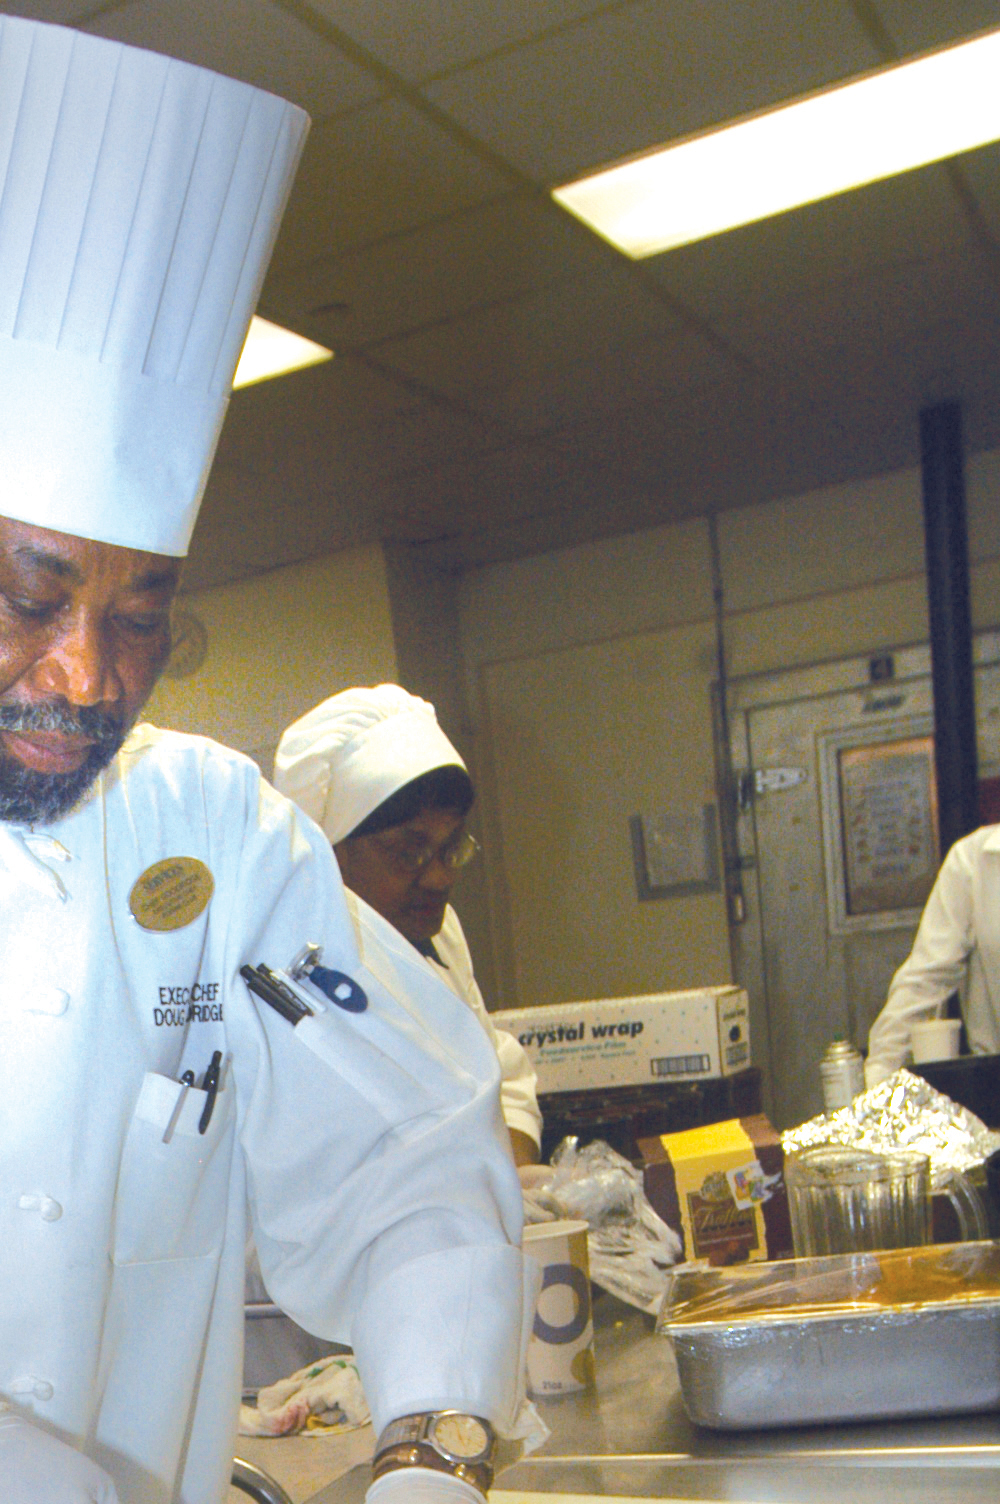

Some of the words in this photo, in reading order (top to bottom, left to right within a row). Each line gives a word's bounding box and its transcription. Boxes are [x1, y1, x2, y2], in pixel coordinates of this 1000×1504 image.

[191, 983, 219, 1001] CHEF
[519, 1021, 585, 1048] crystal
[591, 1020, 644, 1038] wrap
